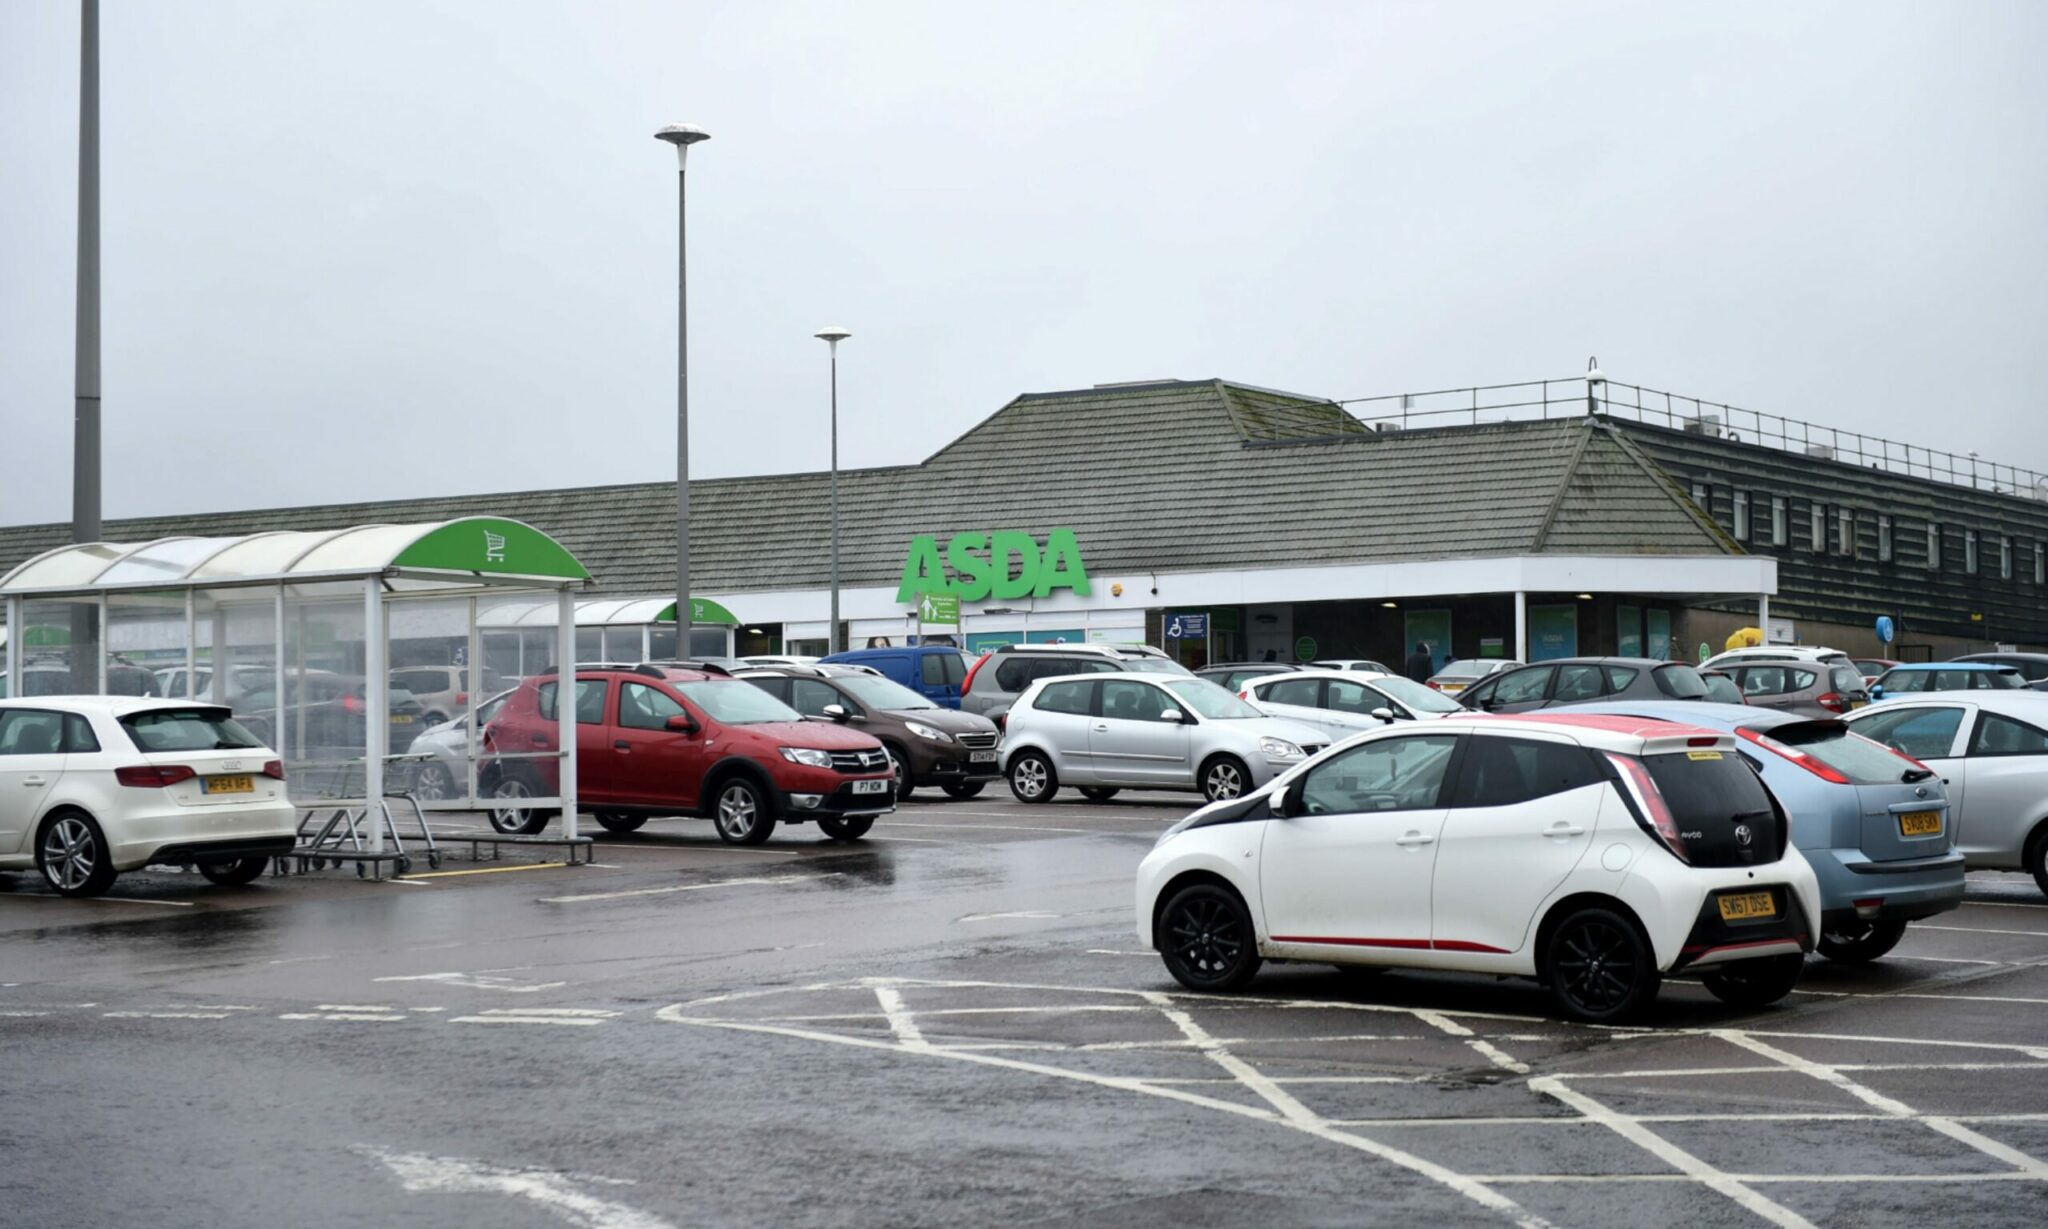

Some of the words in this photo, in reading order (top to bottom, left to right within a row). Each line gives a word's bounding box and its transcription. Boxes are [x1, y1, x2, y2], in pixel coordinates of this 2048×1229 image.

[896, 528, 1091, 603] ASDA
[1722, 896, 1748, 916] SW67
[1750, 893, 1771, 913] DSE
